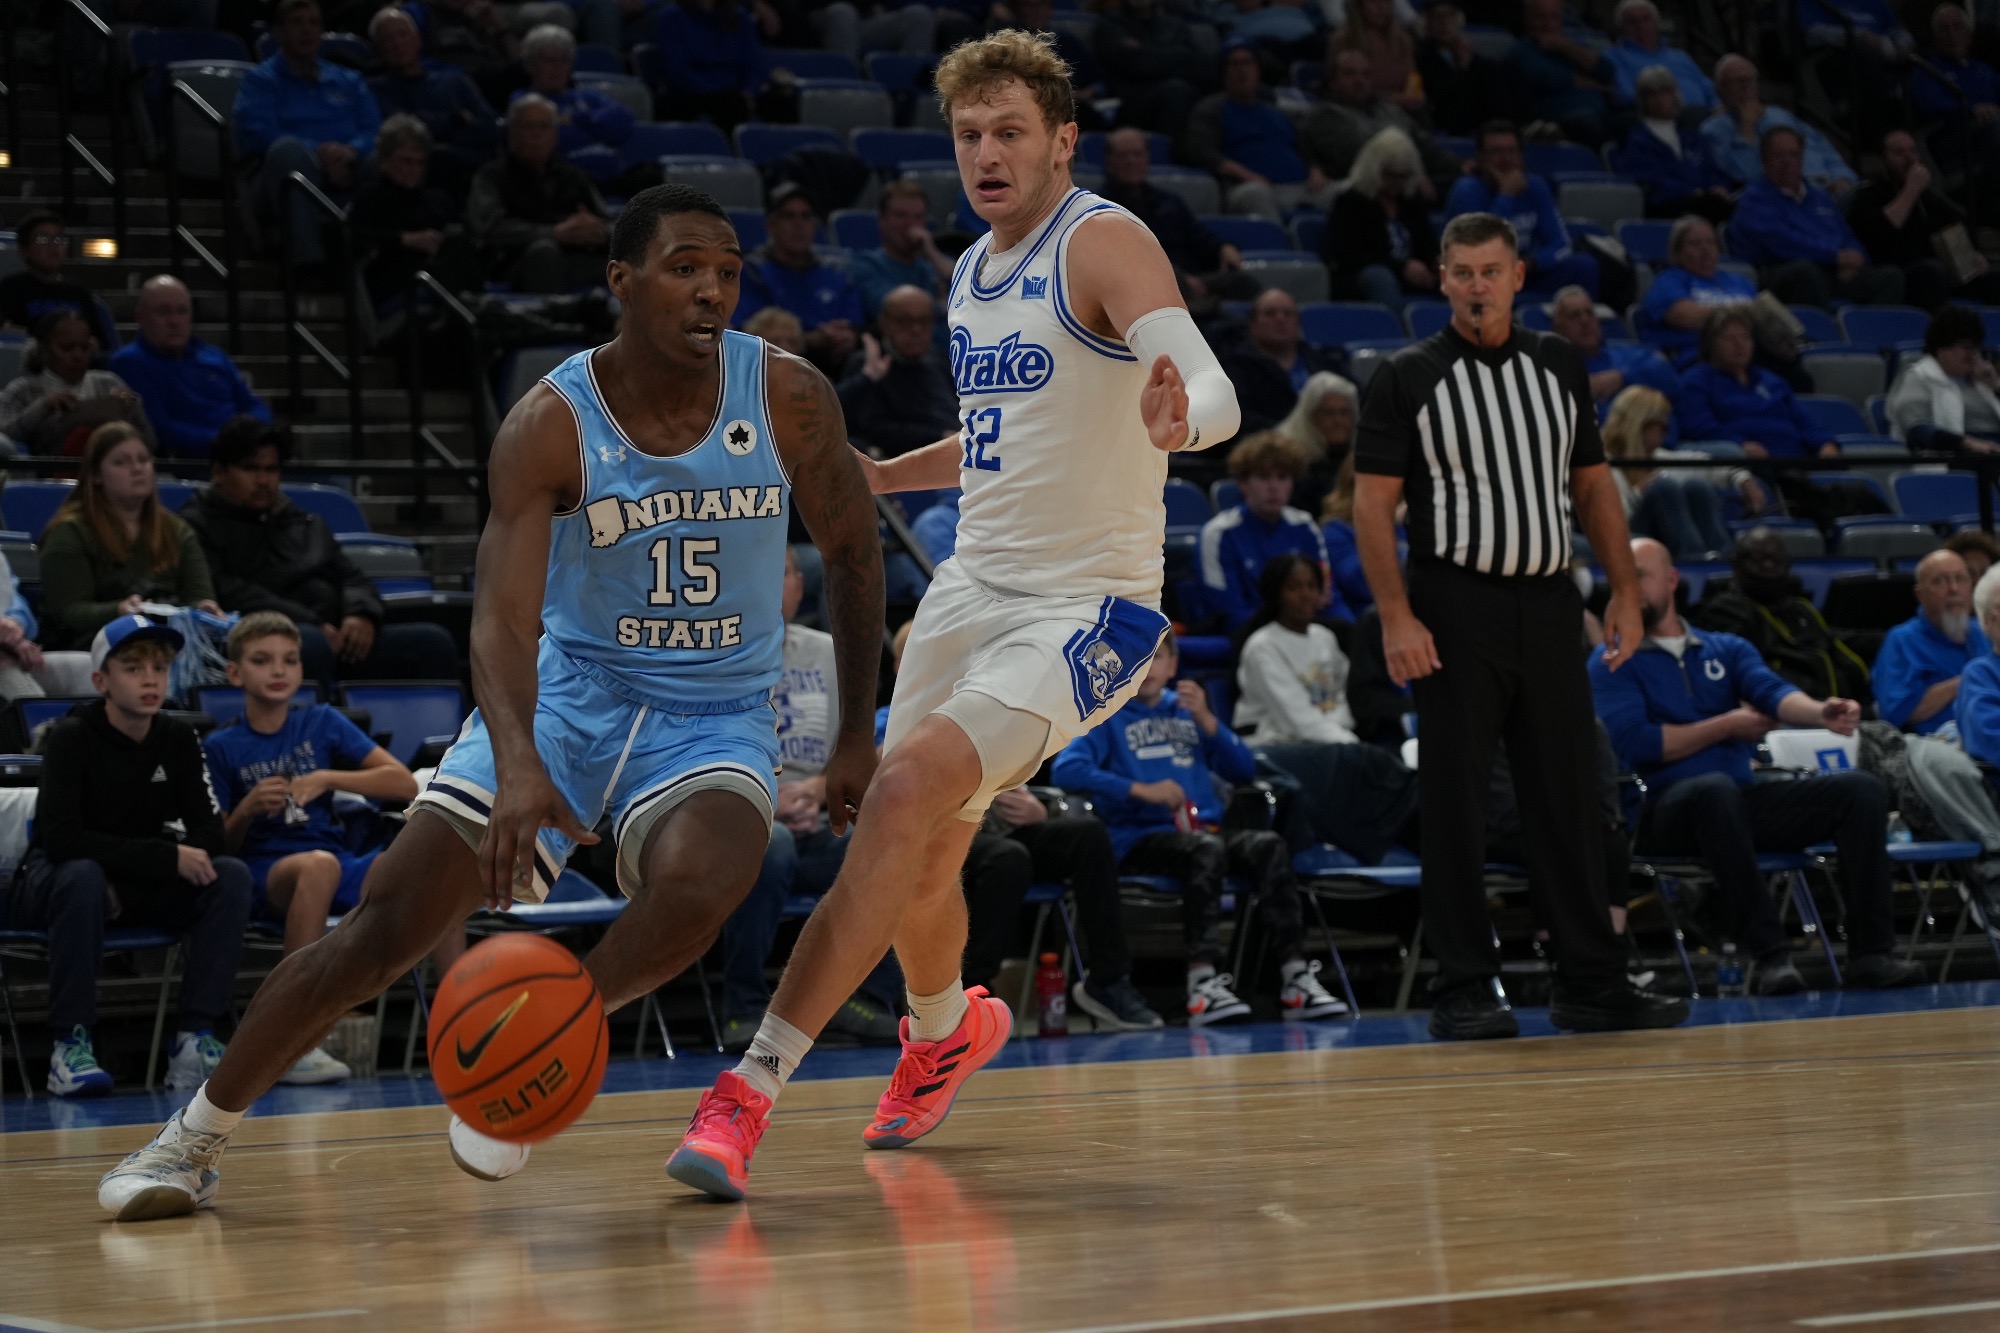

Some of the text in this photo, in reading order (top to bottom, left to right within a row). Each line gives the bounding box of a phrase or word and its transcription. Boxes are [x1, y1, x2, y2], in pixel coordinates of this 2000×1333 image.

[950, 327, 1053, 394] Drake
[963, 408, 1002, 471] 12
[647, 536, 719, 607] 15
[616, 614, 742, 649] STATE
[479, 1057, 569, 1130] ELITE
[757, 1056, 779, 1076] adidas
